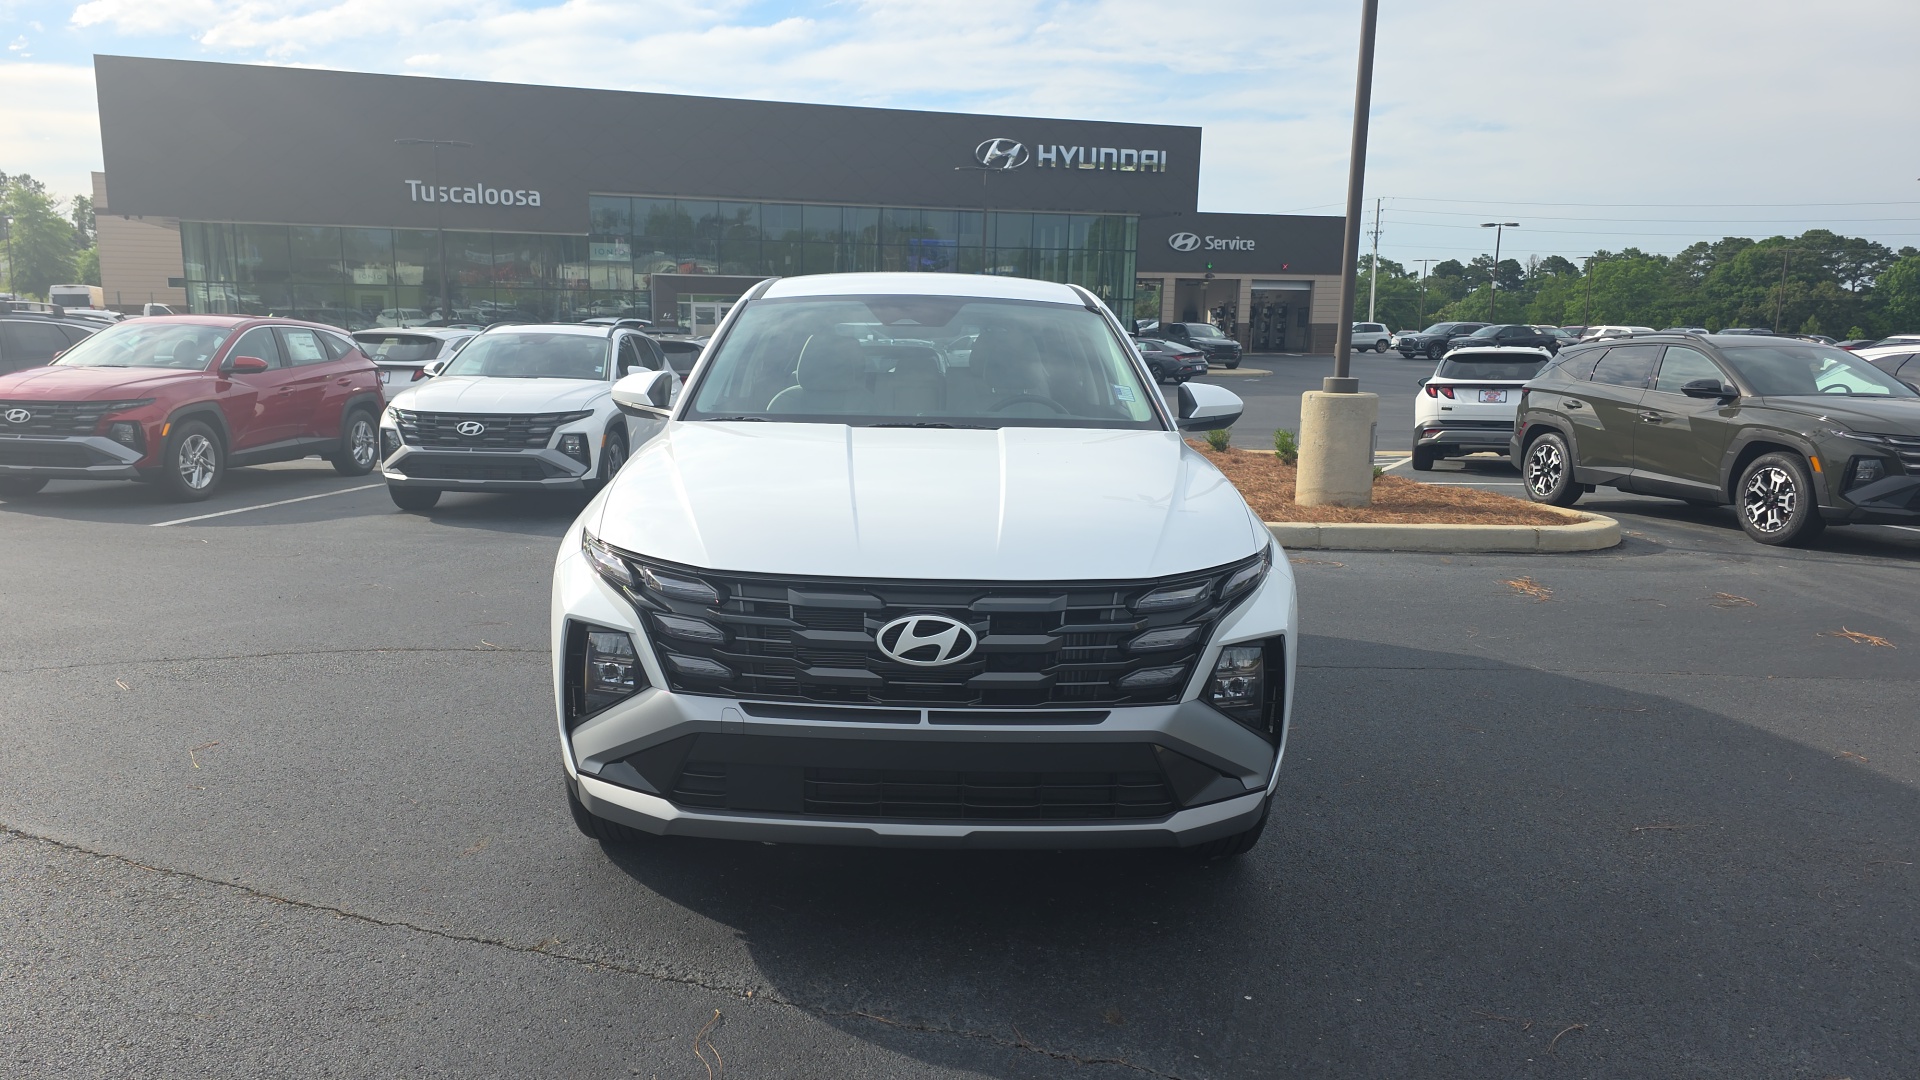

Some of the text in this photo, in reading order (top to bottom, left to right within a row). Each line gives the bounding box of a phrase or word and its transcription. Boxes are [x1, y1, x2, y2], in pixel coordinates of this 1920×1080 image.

[1037, 144, 1167, 173] HYUNDAI
[404, 179, 542, 207] Tuscaloosa
[1204, 235, 1255, 251] Service
